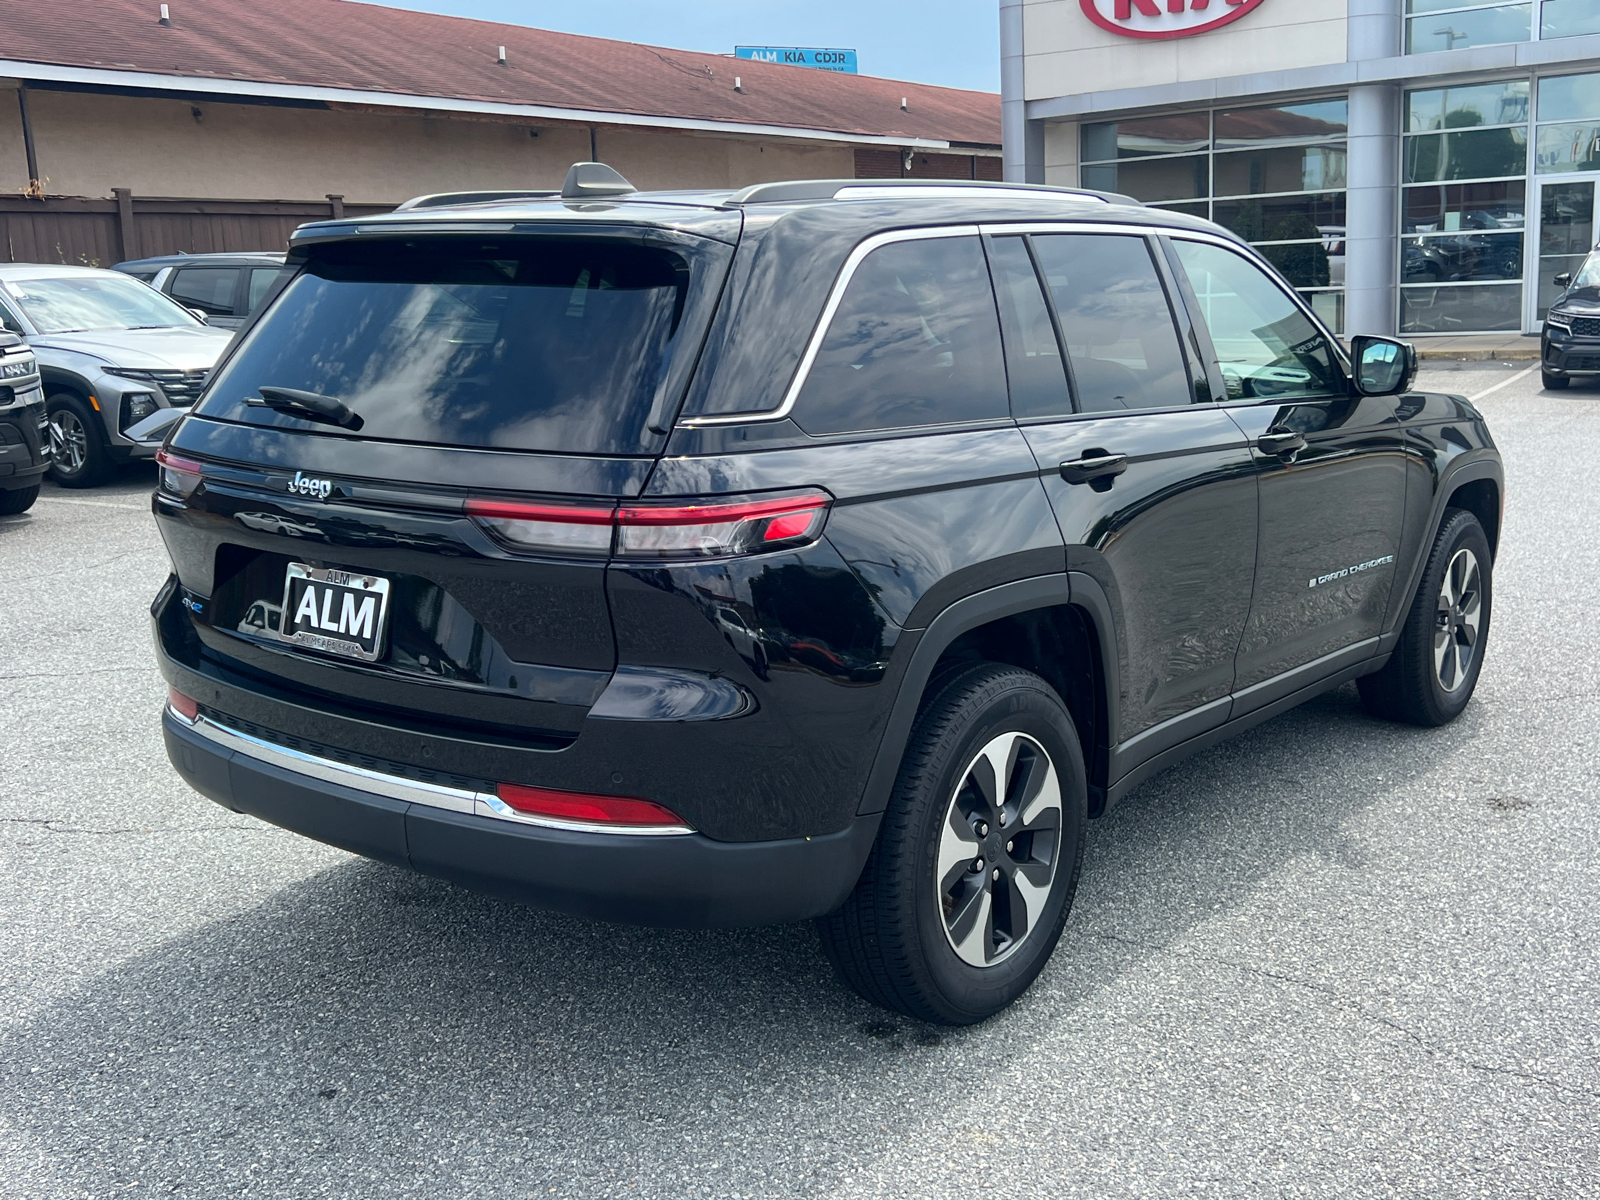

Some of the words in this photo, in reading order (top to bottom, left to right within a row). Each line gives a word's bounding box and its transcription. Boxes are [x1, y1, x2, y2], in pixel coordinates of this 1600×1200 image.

[751, 51, 777, 62] ALM
[784, 51, 806, 63] KIA
[815, 52, 846, 63] CDJR
[287, 471, 332, 499] Jeep
[326, 570, 350, 586] ALM
[1318, 569, 1348, 584] GRAND
[1349, 555, 1393, 574] CHEROKEE
[294, 585, 376, 639] ALM
